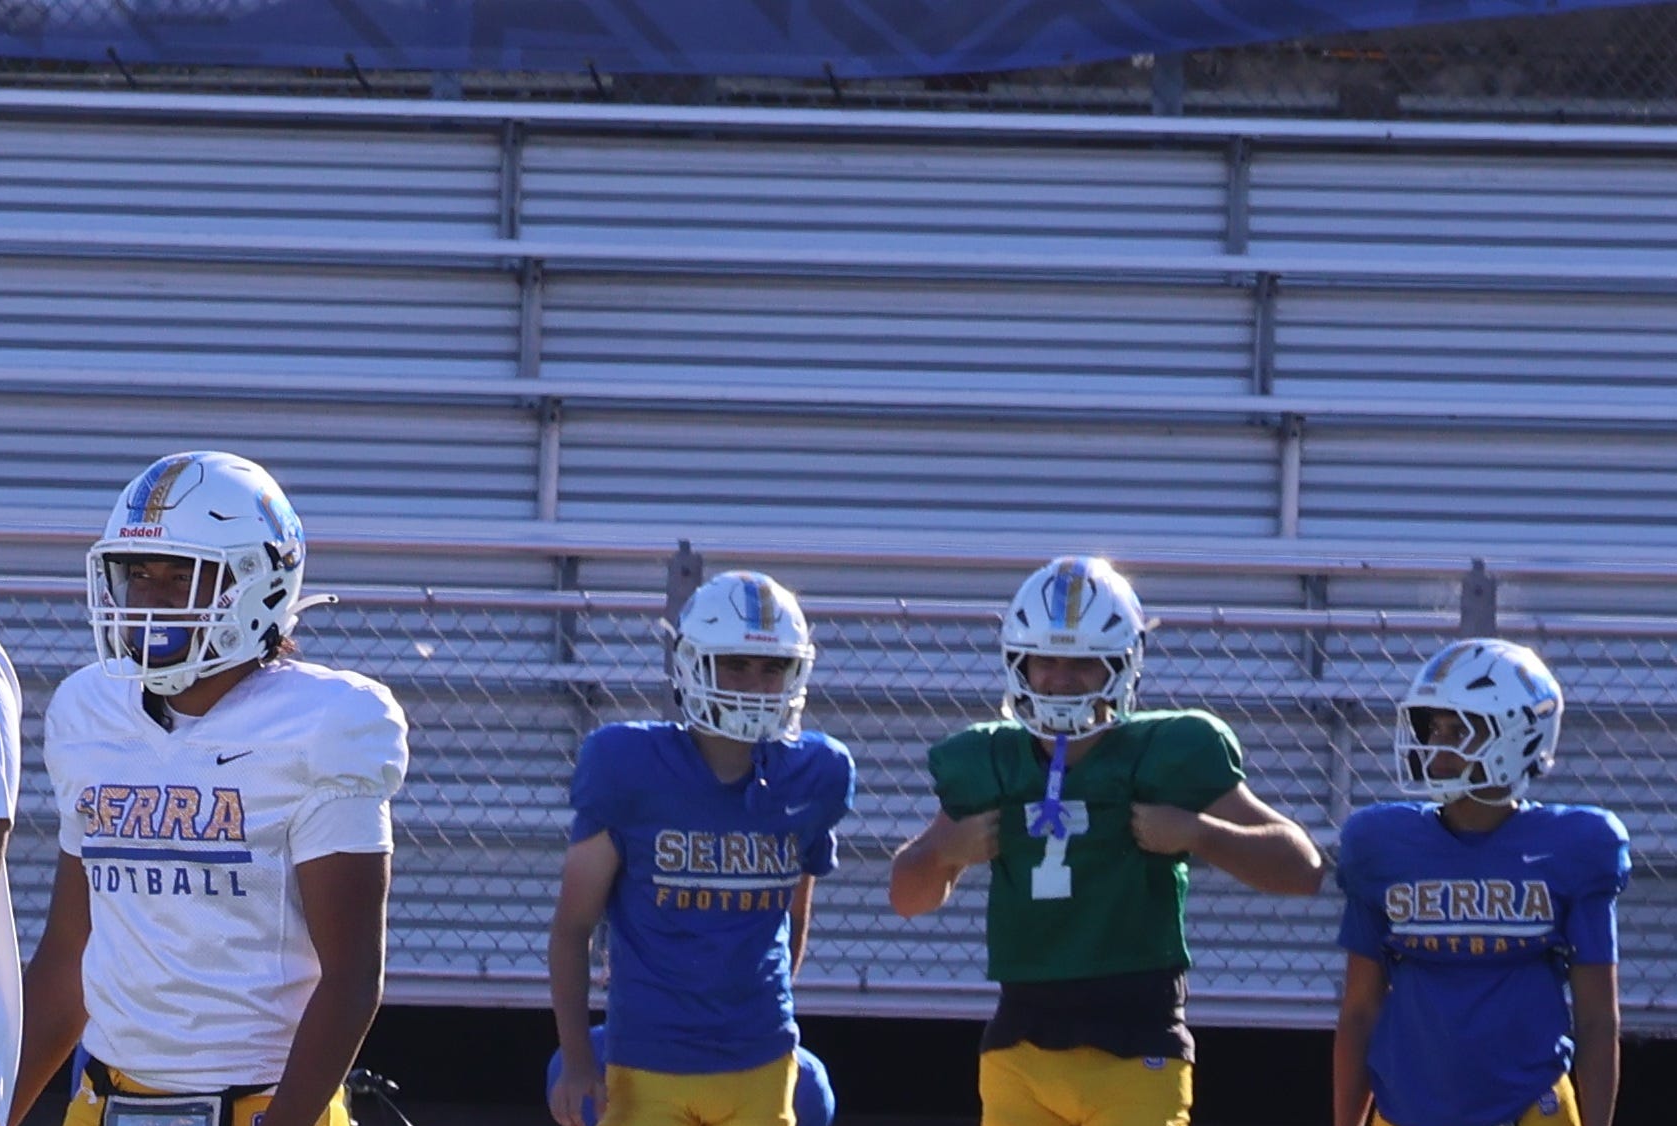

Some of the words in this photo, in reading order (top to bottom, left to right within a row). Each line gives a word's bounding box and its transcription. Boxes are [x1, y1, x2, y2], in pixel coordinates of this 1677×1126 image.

[119, 526, 163, 538] Riddell
[75, 784, 246, 842] SERRA
[655, 829, 802, 874] SERRA
[90, 863, 248, 897] OOTBALL
[1385, 879, 1555, 923] SERRA
